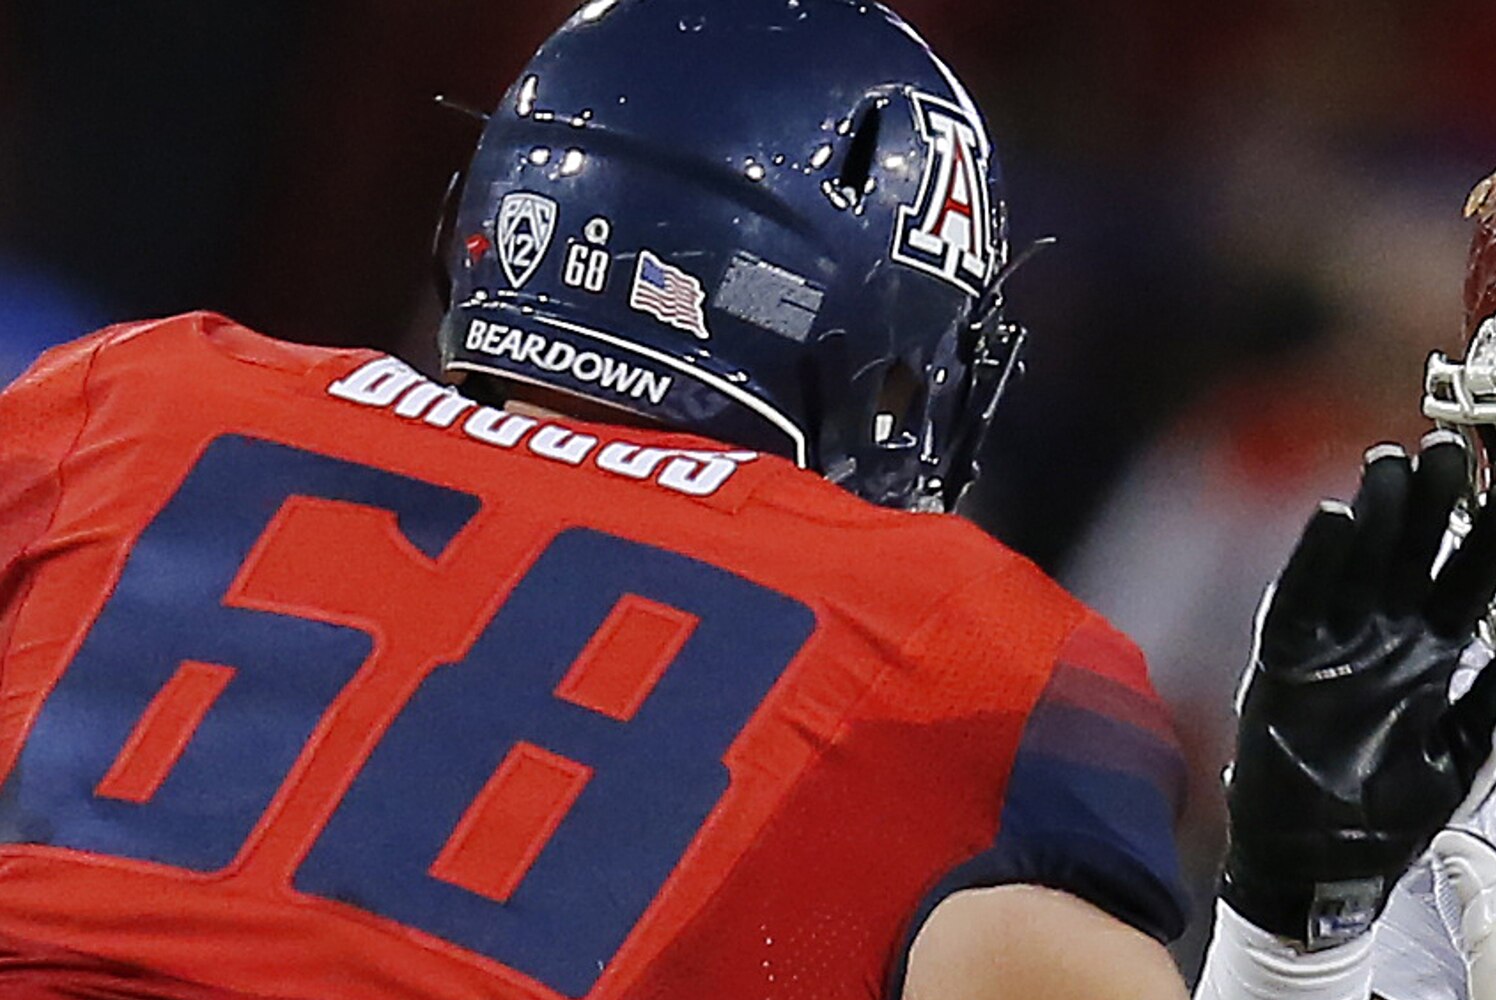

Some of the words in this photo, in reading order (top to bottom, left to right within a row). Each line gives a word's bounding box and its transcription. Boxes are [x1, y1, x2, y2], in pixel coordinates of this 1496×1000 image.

[506, 233, 533, 267] 12
[564, 243, 609, 292] 68
[465, 319, 672, 405] BEARDOWN
[0, 432, 818, 999] 68
